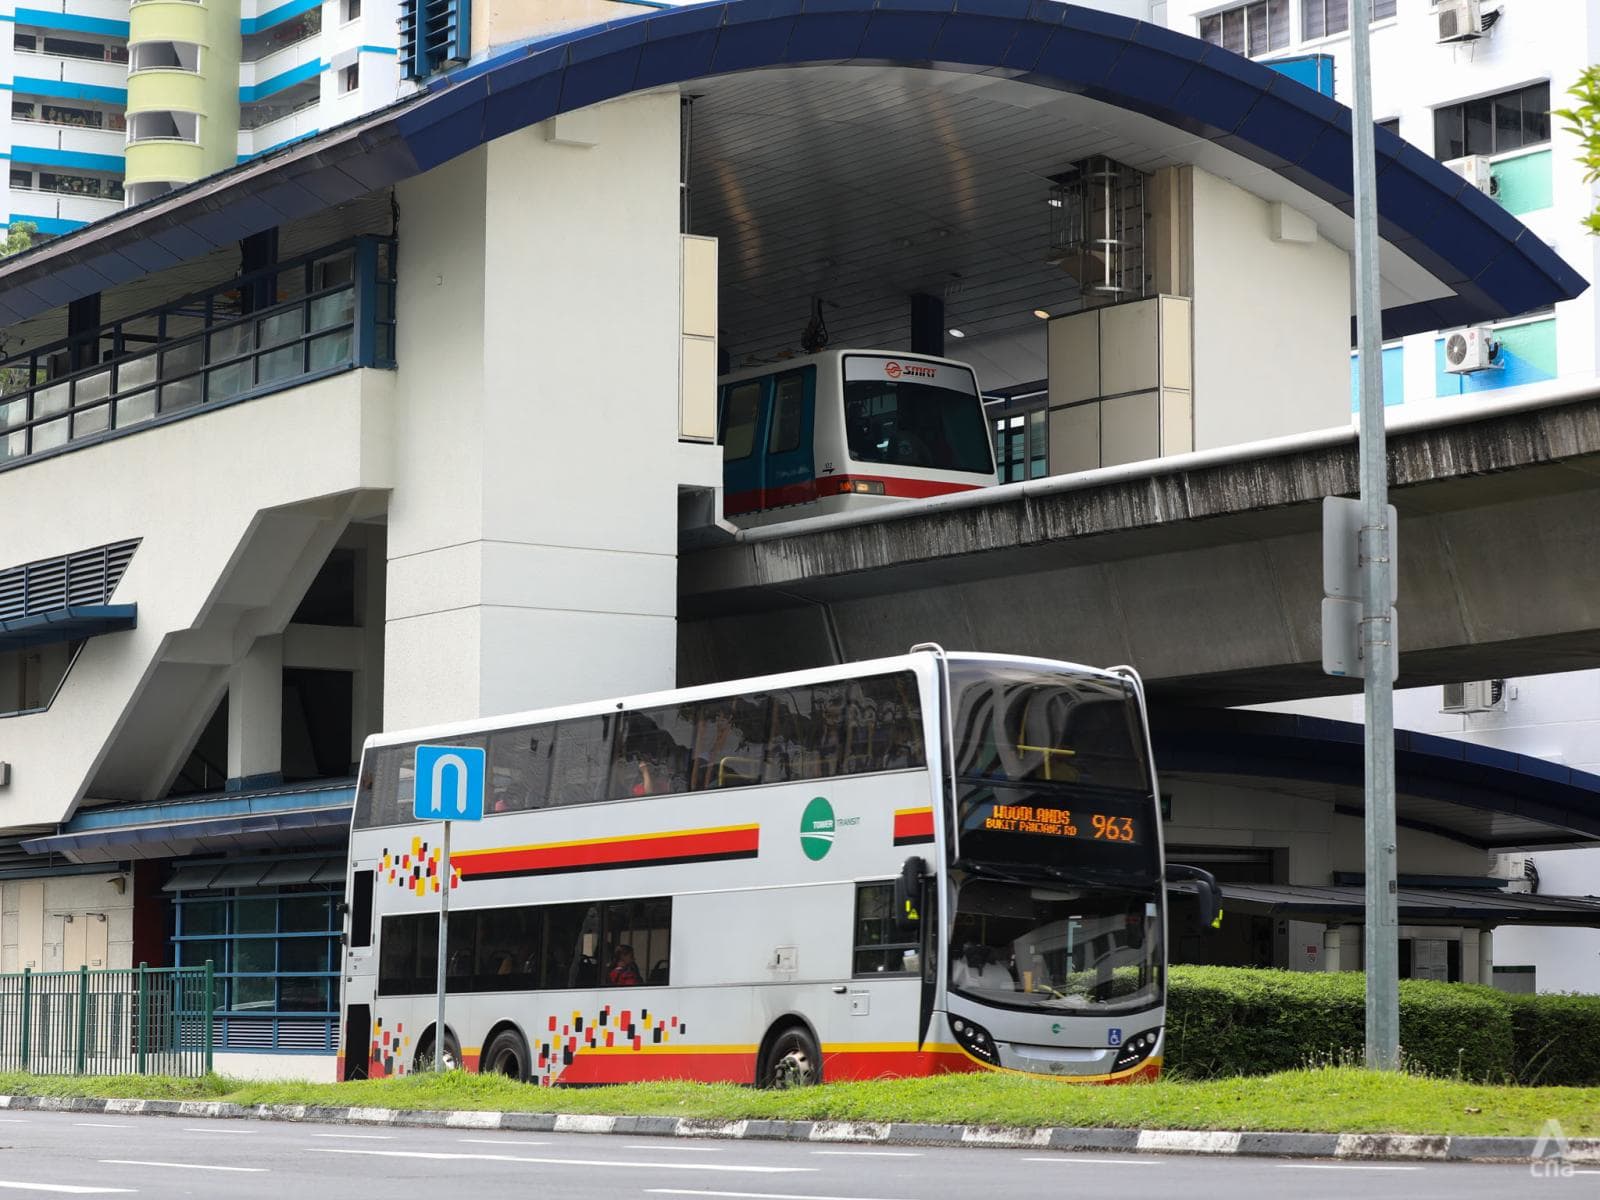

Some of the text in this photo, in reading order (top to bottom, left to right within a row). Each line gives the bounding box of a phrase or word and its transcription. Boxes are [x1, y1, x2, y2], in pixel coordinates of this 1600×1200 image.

[903, 366, 937, 378] SMRT
[993, 805, 1070, 825] WOODLANDS
[985, 818, 1017, 831] BUKIT
[1091, 814, 1134, 841] 963
